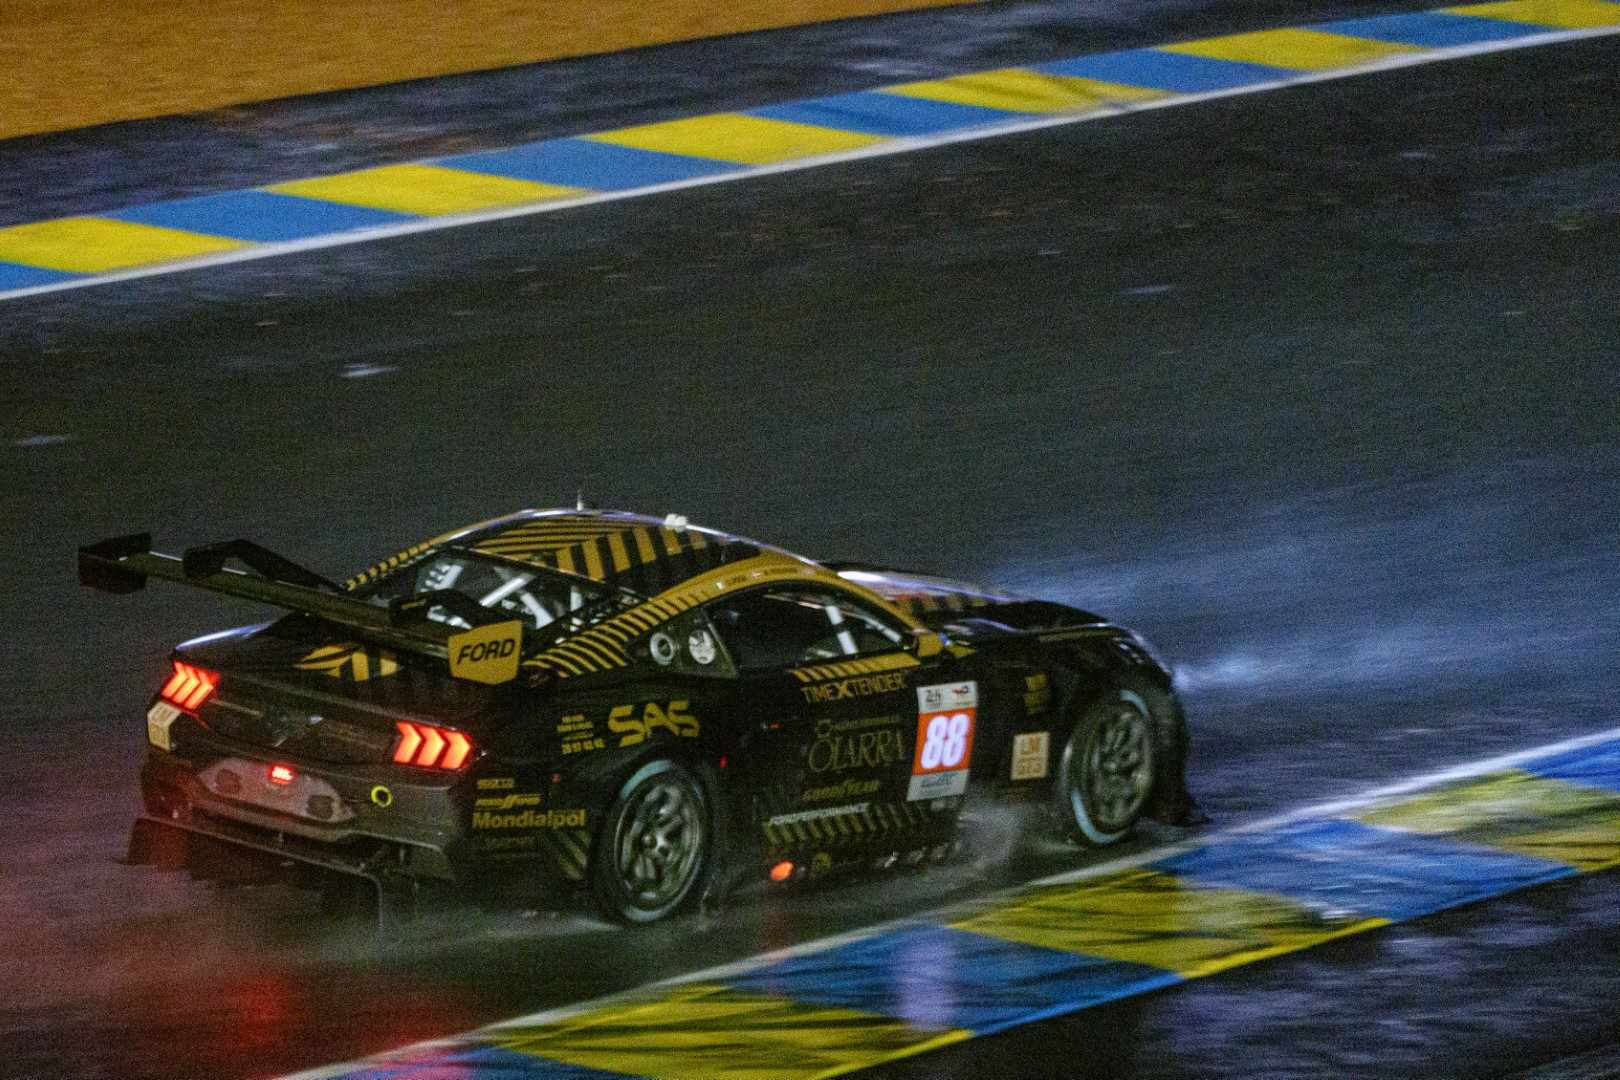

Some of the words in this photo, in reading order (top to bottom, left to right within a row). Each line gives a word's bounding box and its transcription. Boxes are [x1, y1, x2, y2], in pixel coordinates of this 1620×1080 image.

[457, 638, 515, 665] FORD
[802, 672, 905, 704] TIMEXTENDER
[607, 700, 699, 748] SAS
[920, 713, 971, 770] 88
[472, 809, 586, 830] Mondialpol
